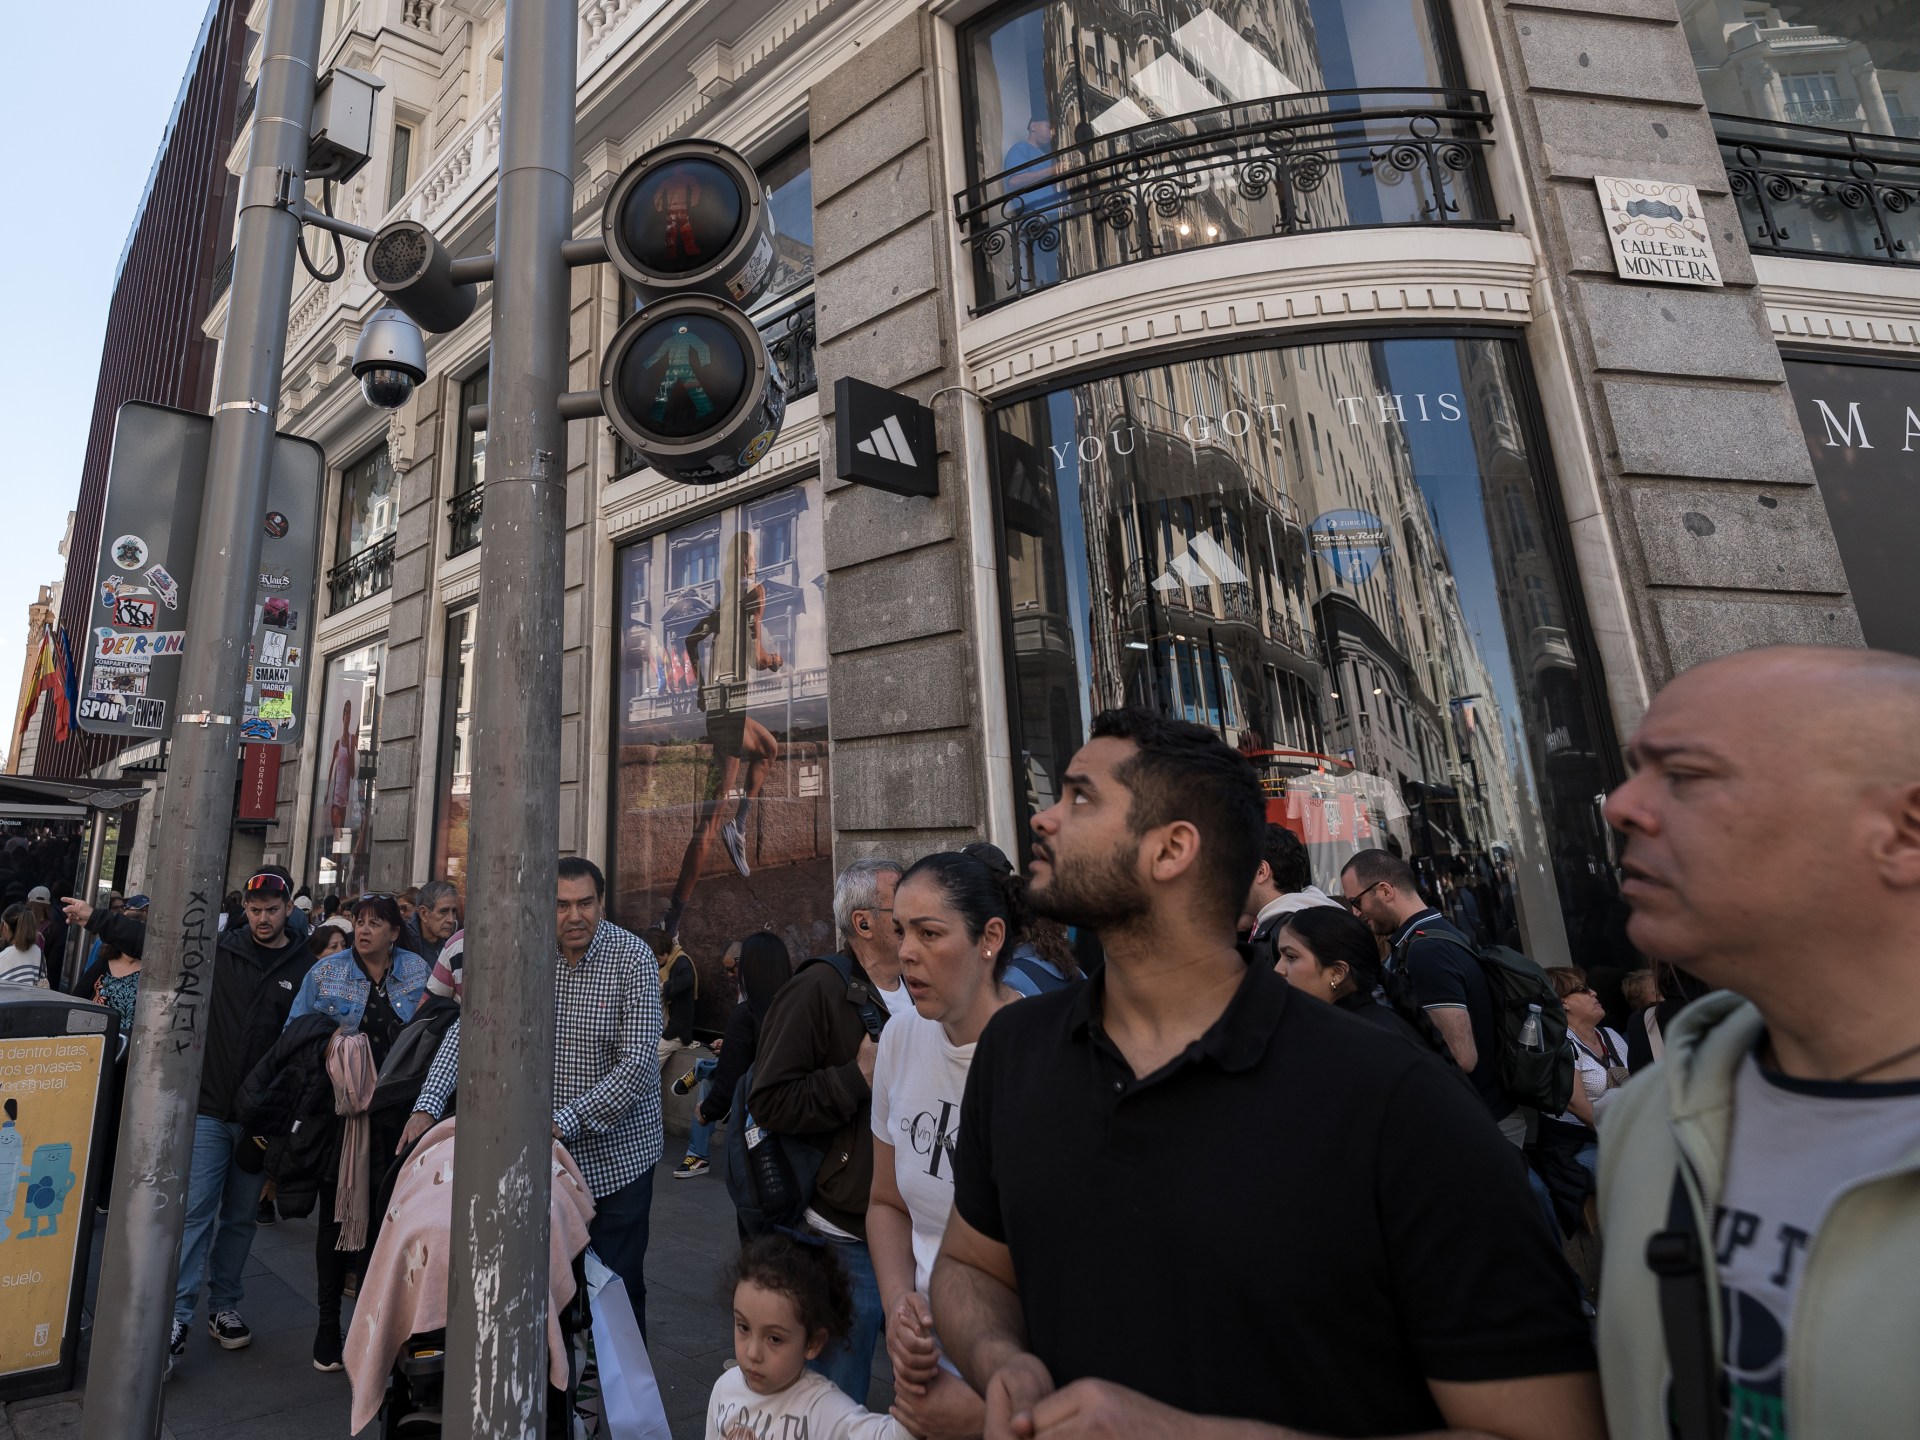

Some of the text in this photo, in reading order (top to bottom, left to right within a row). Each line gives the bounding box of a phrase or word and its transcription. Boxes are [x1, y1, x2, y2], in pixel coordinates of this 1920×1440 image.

[1620, 238, 1708, 259] CALLE DE LA
[1623, 255, 1717, 282] MONTERA
[1049, 393, 1462, 471] YOU GOT THIS
[94, 658, 128, 668] COMPARTE
[255, 667, 288, 681] SMAK47
[261, 683, 285, 692] MADRIZ
[80, 699, 120, 721] SPON
[7, 1045, 52, 1060] dentro
[55, 1043, 89, 1058] latas,
[24, 1061, 82, 1075] envases
[900, 1117, 931, 1141] Calvin
[1, 1269, 43, 1288] suelo.
[25, 1349, 52, 1358] MADRID
